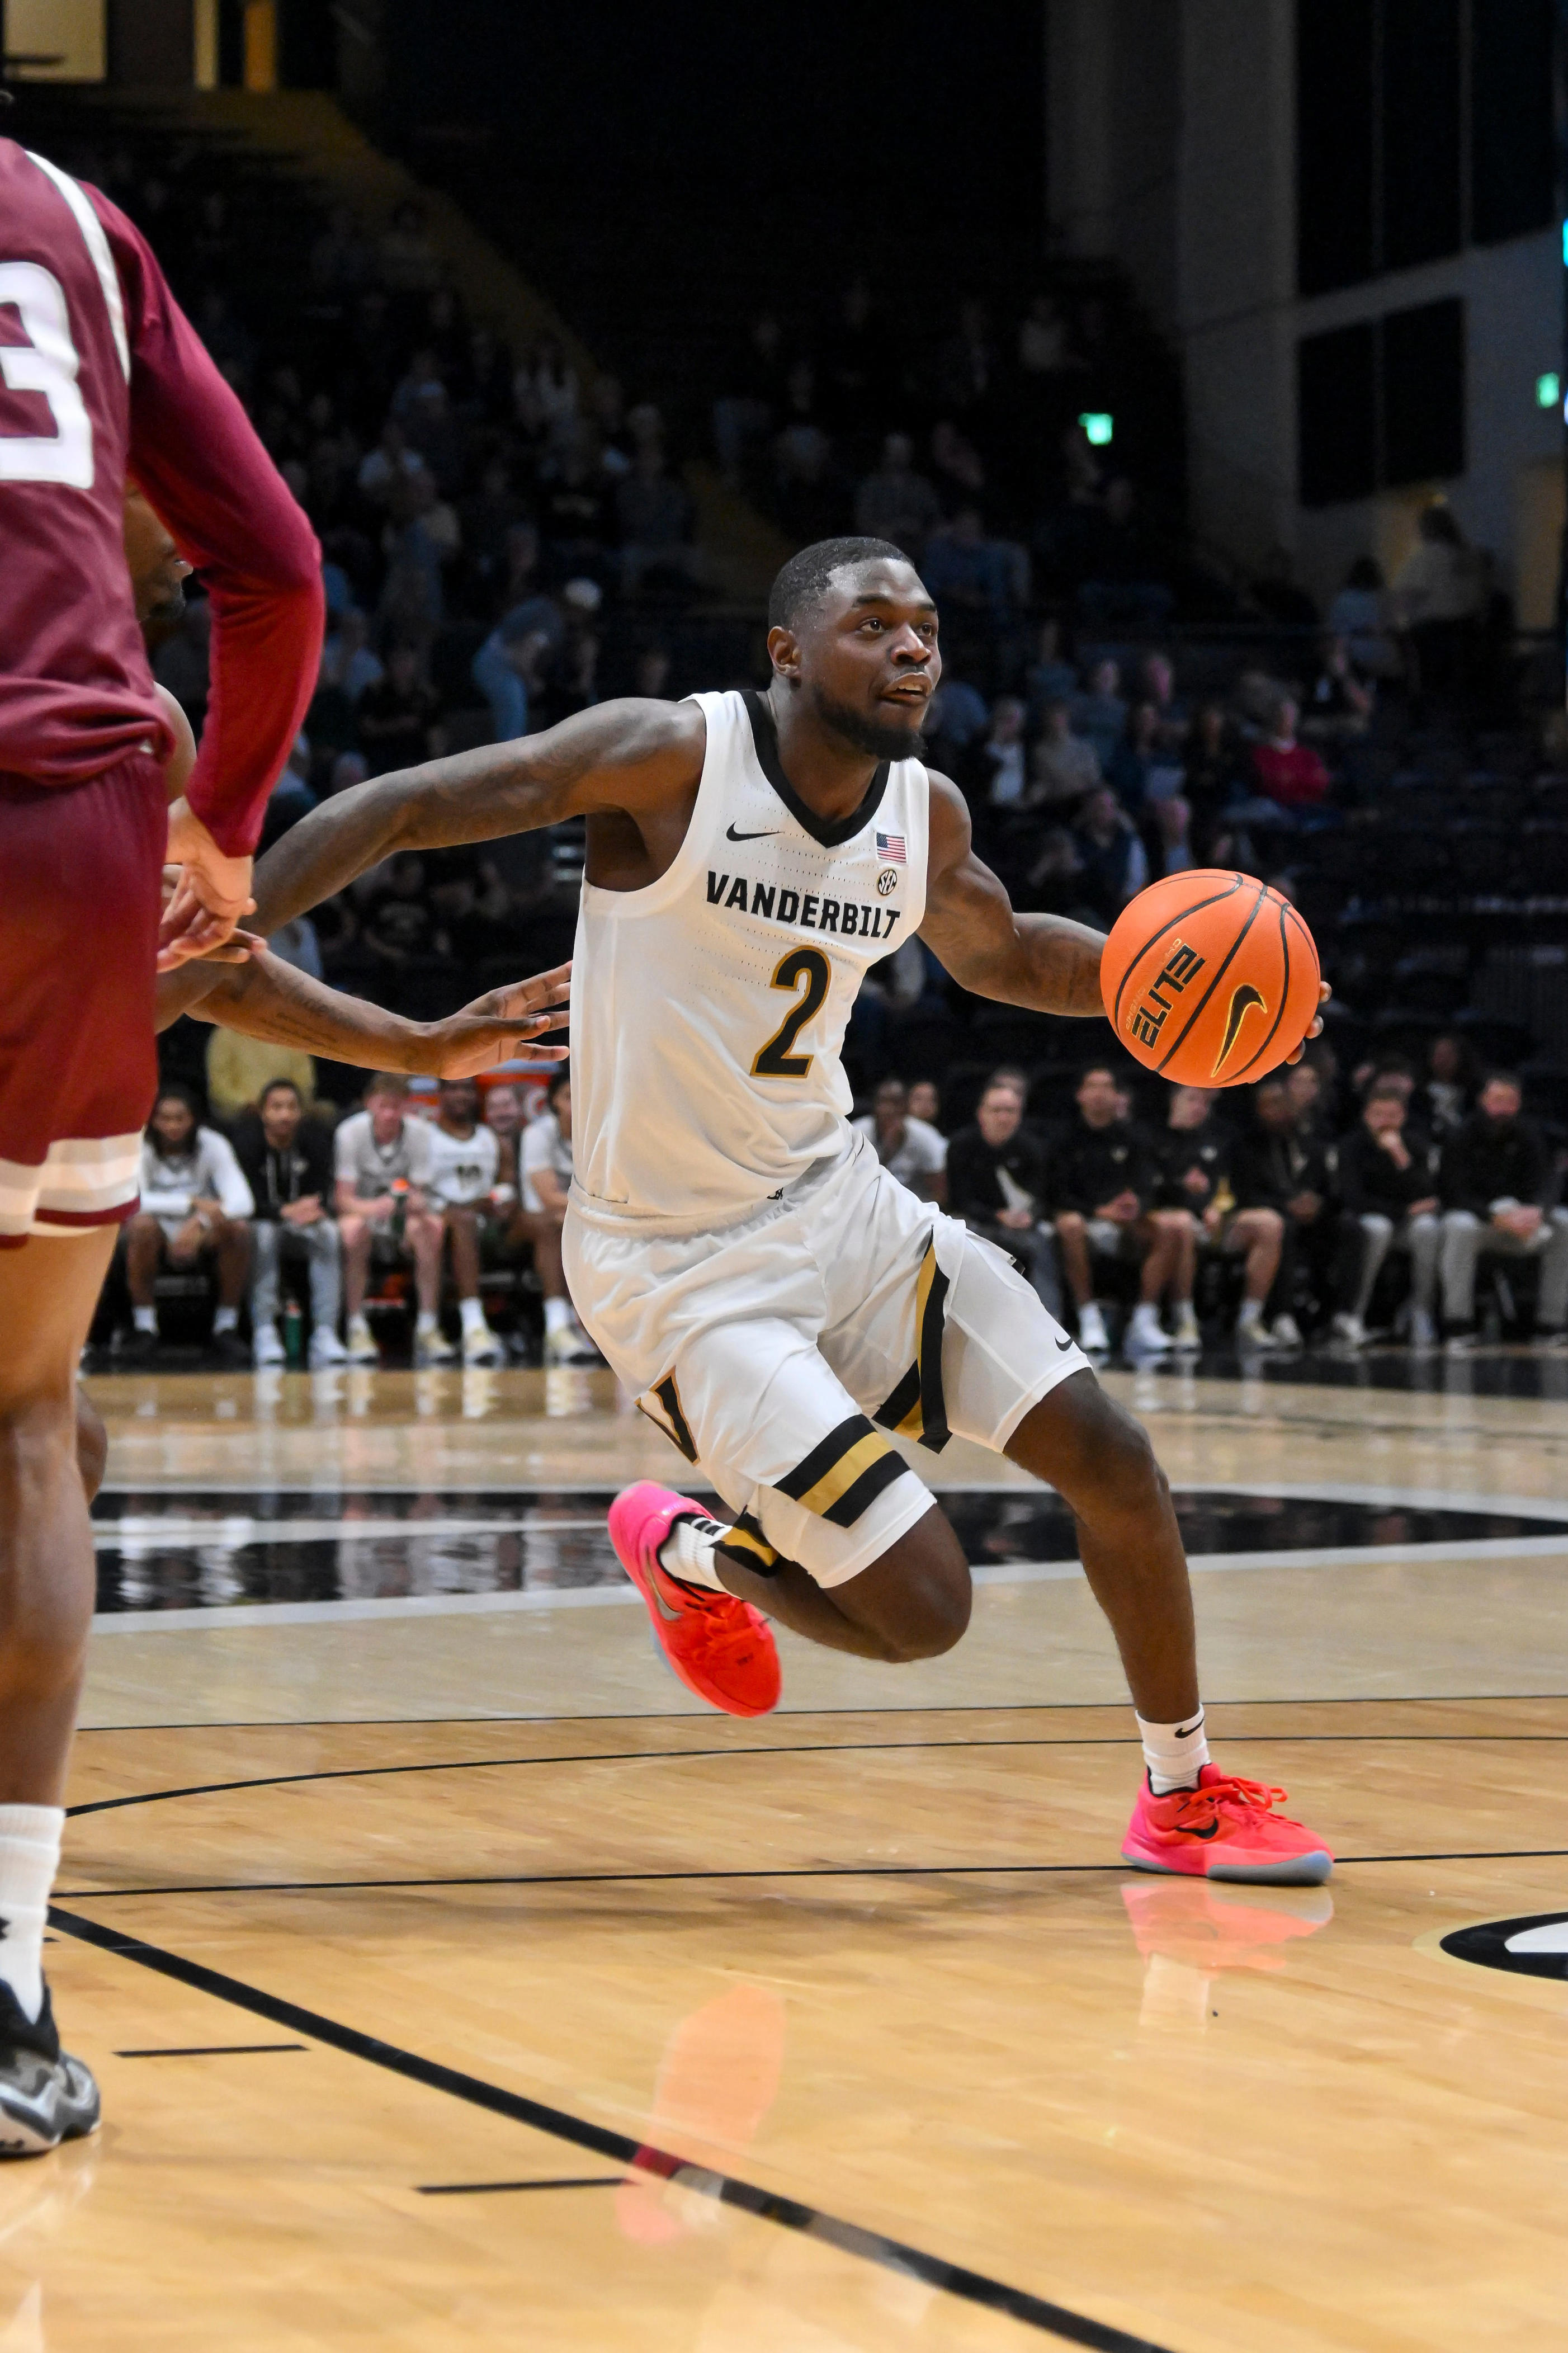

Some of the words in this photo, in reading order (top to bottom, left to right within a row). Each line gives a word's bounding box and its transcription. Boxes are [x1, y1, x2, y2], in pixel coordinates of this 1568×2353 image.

[707, 870, 901, 939] VANDERBILT
[878, 869, 898, 895] SEC
[749, 945, 832, 1078] 2
[1130, 943, 1206, 1050] ELITE
